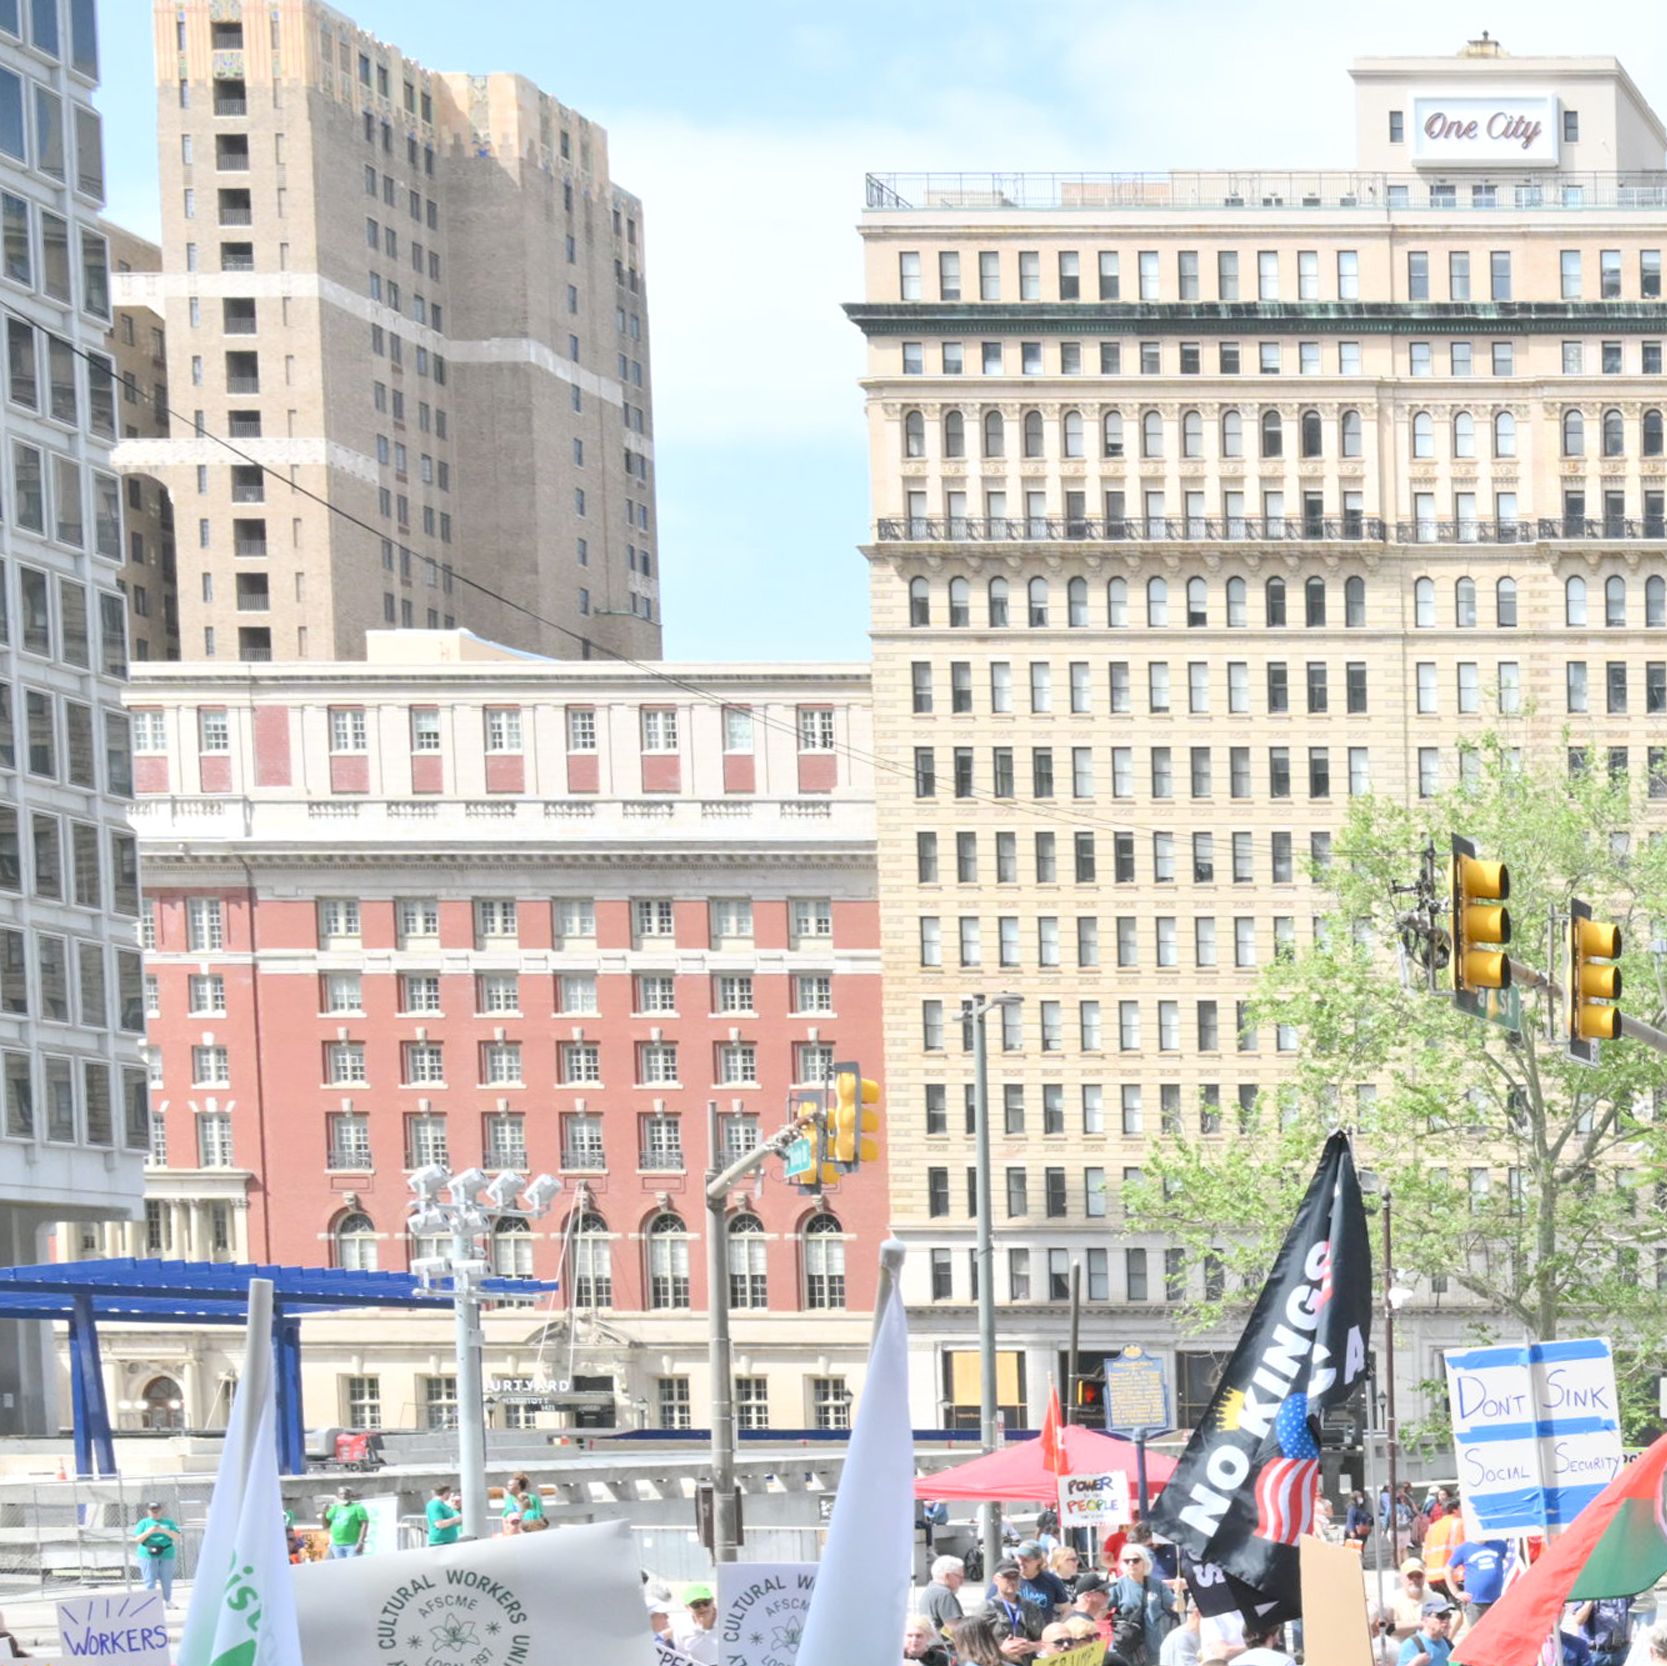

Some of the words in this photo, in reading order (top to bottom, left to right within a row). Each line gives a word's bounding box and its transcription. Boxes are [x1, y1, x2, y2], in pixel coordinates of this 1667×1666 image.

[1424, 112, 1478, 139] One
[1487, 112, 1542, 149] City
[1178, 1443, 1250, 1538] NO
[1235, 1240, 1333, 1441] KINGS
[1458, 1376, 1525, 1419] DON'T
[1543, 1369, 1608, 1410] SINK
[1464, 1448, 1530, 1487] SOCIAL
[1553, 1442, 1620, 1481] SECURITY
[1068, 1476, 1113, 1494] POWER
[1068, 1499, 1118, 1513] PEOPLE
[378, 1574, 436, 1650] CULTURAL
[446, 1569, 528, 1624] WORKERS
[418, 1594, 478, 1618] AFSCME
[723, 1575, 787, 1642] CULTURAL
[764, 1598, 811, 1617] AFSCM
[64, 1625, 170, 1656] WORKERS
